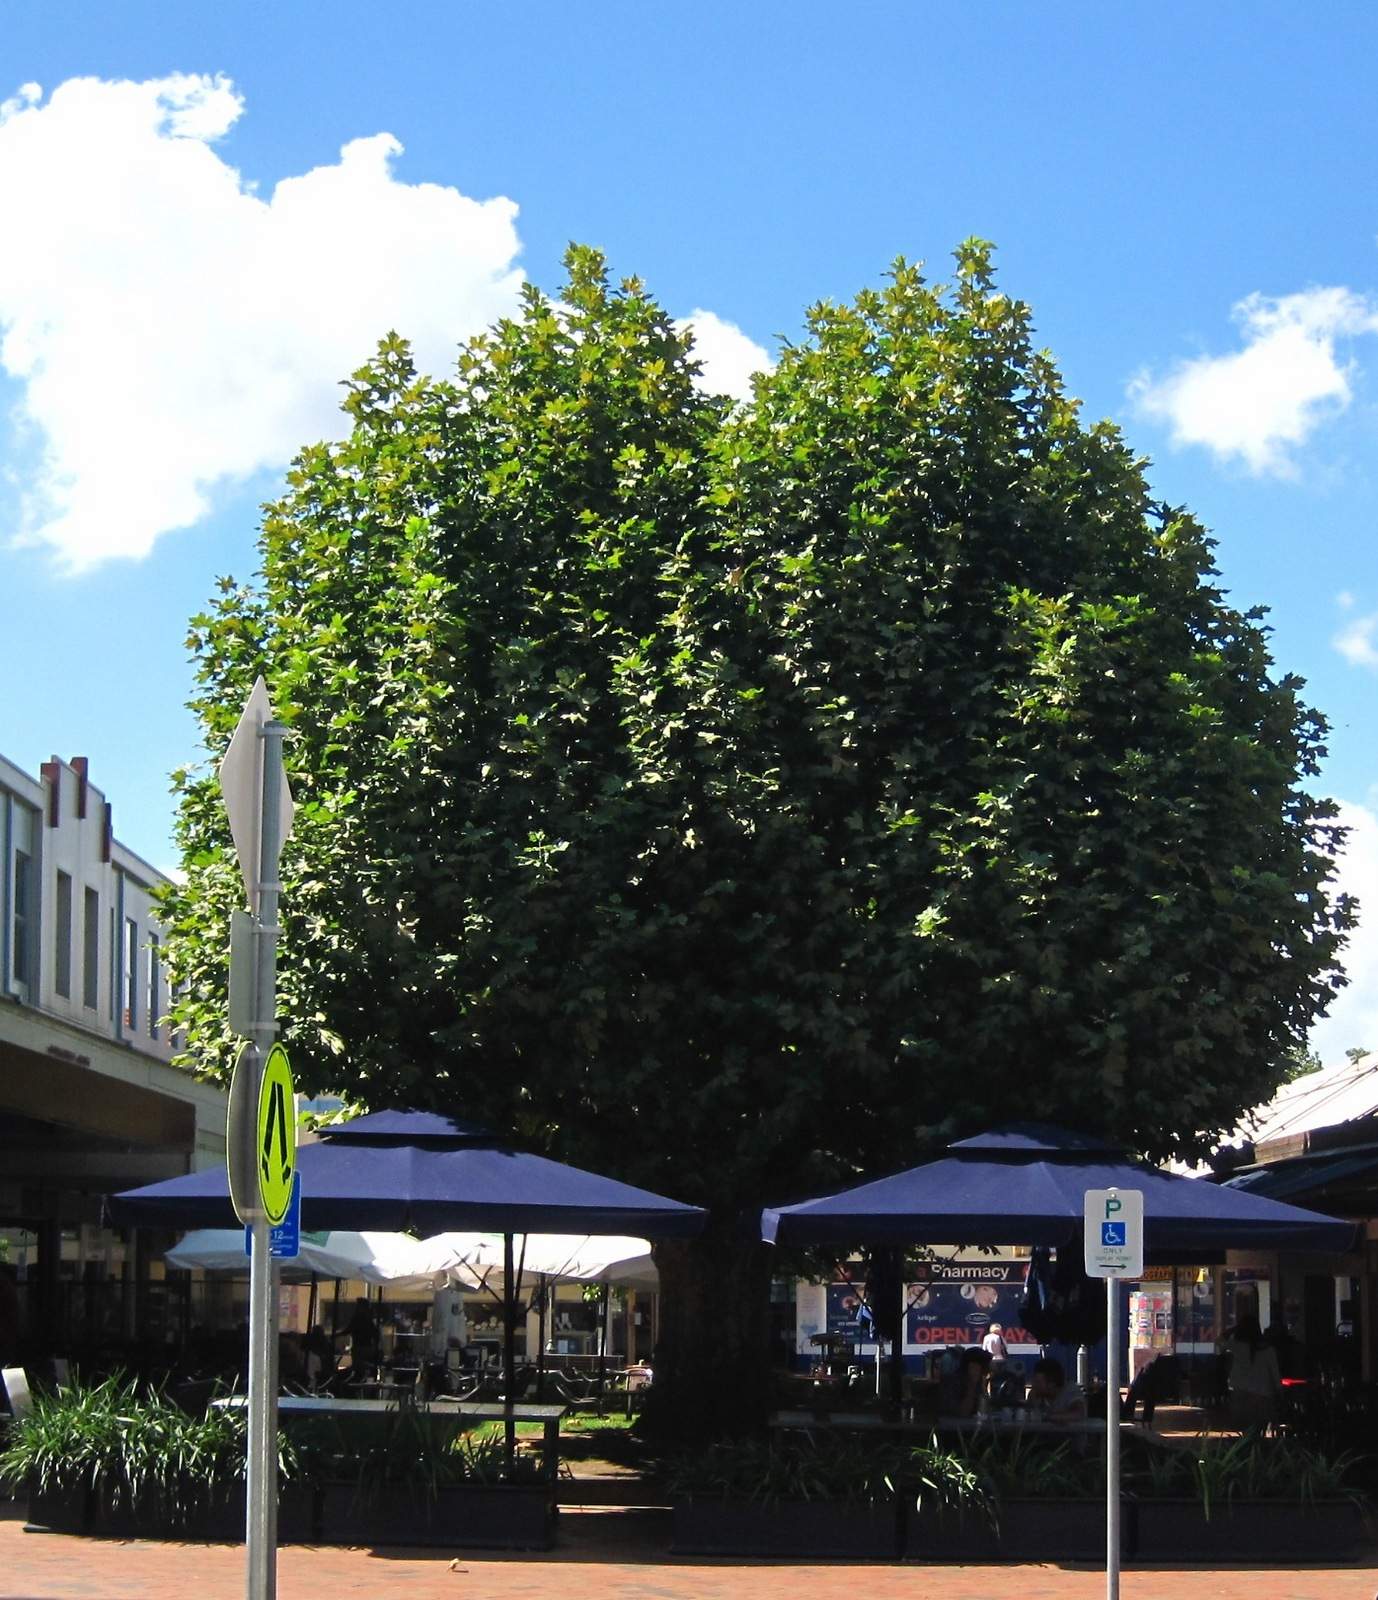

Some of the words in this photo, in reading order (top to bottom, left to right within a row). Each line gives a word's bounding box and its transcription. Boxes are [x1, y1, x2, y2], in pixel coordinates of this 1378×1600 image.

[1106, 1199, 1122, 1219] P
[915, 1327, 970, 1344] OPEN
[974, 1327, 985, 1344] 7
[998, 1327, 1038, 1344] AYS
